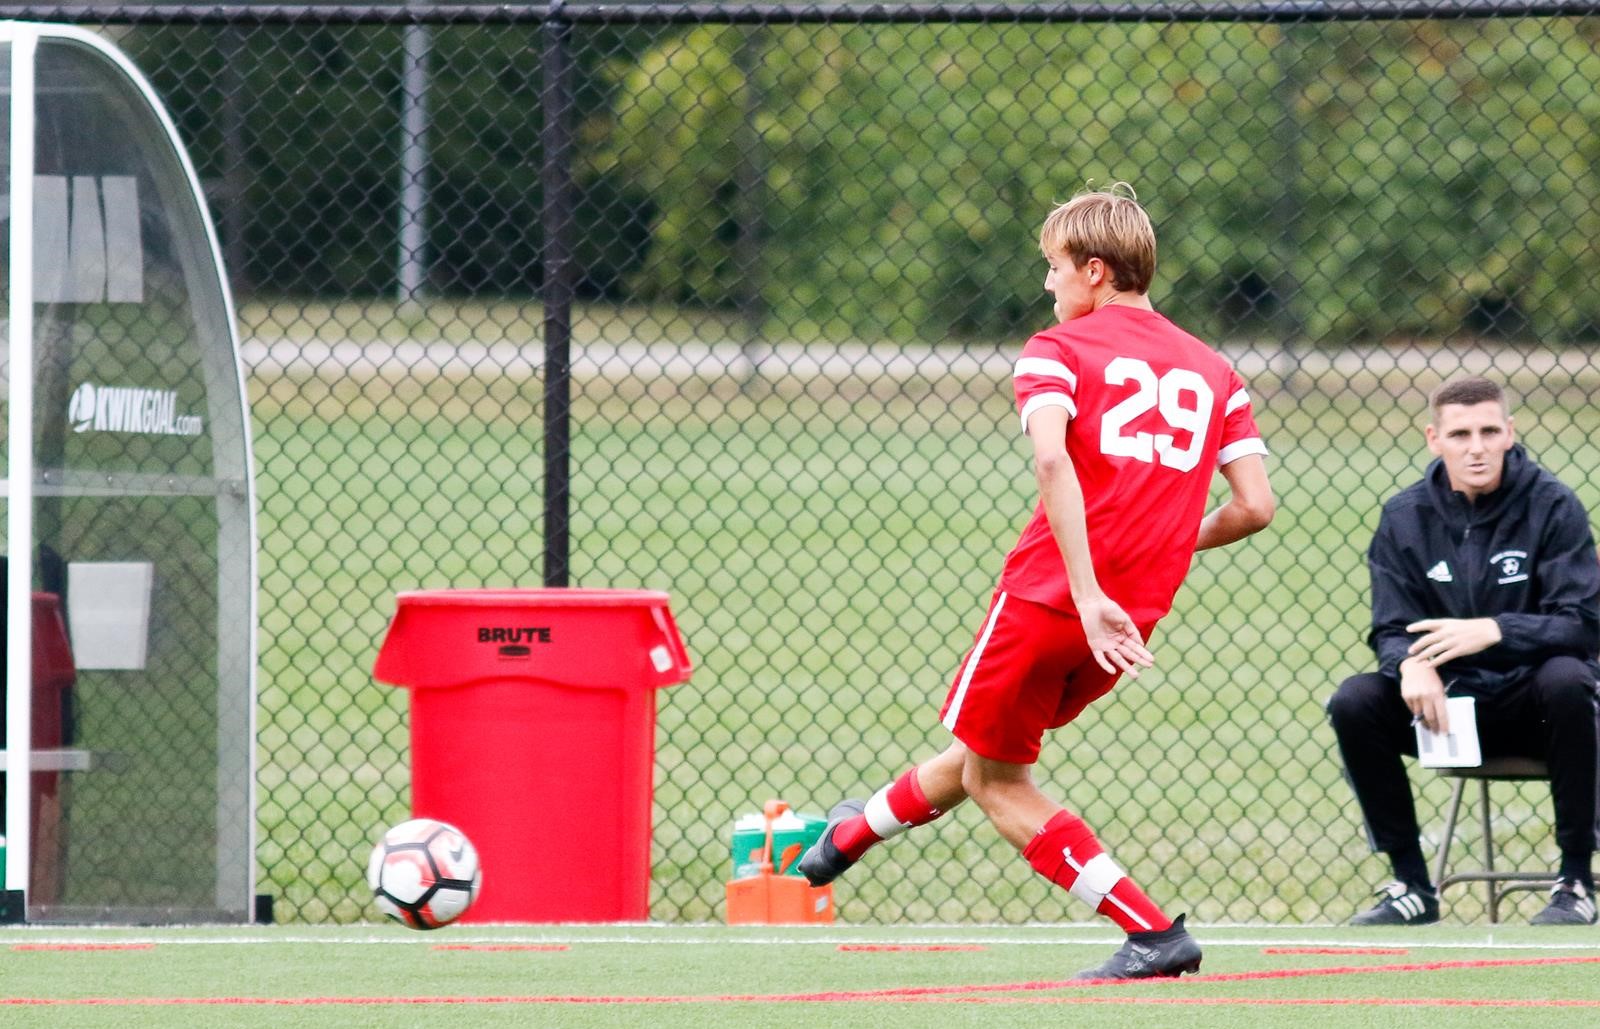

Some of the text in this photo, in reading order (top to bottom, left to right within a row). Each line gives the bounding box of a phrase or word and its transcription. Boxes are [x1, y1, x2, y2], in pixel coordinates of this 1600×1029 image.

[1100, 356, 1214, 473] 29
[478, 627, 551, 643] BRUTE
[1126, 948, 1161, 974] adias
